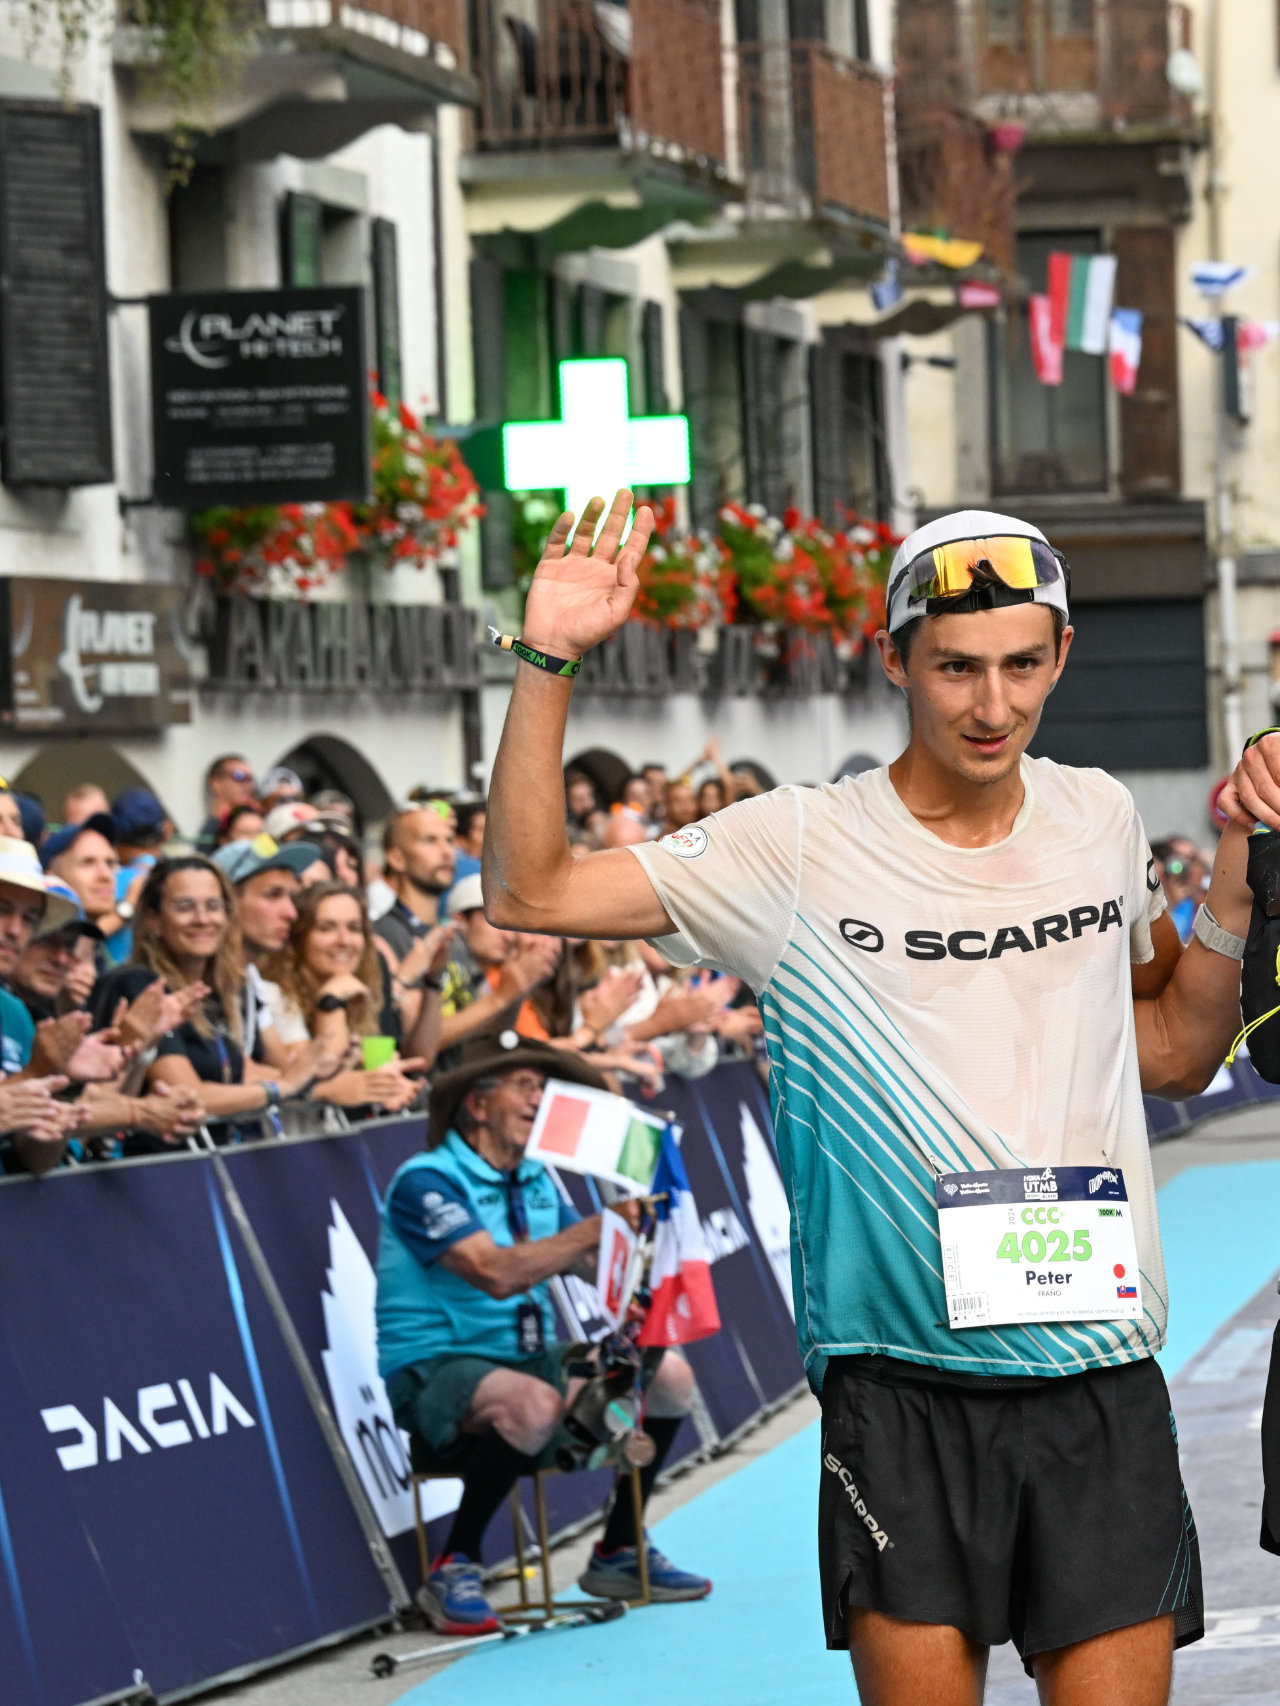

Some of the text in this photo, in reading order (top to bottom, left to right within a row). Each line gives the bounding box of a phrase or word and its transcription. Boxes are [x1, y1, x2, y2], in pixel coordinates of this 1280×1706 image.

[200, 310, 337, 340] PLANET
[905, 900, 1123, 961] SCARPA
[1024, 1181, 1058, 1193] UTMB
[1020, 1207, 1061, 1225] CCC
[1099, 1209, 1114, 1217] 100K
[996, 1229, 1093, 1264] 4025
[1025, 1270, 1073, 1285] Peter
[39, 1371, 256, 1472] DACIA
[823, 1453, 889, 1552] SCARPA
